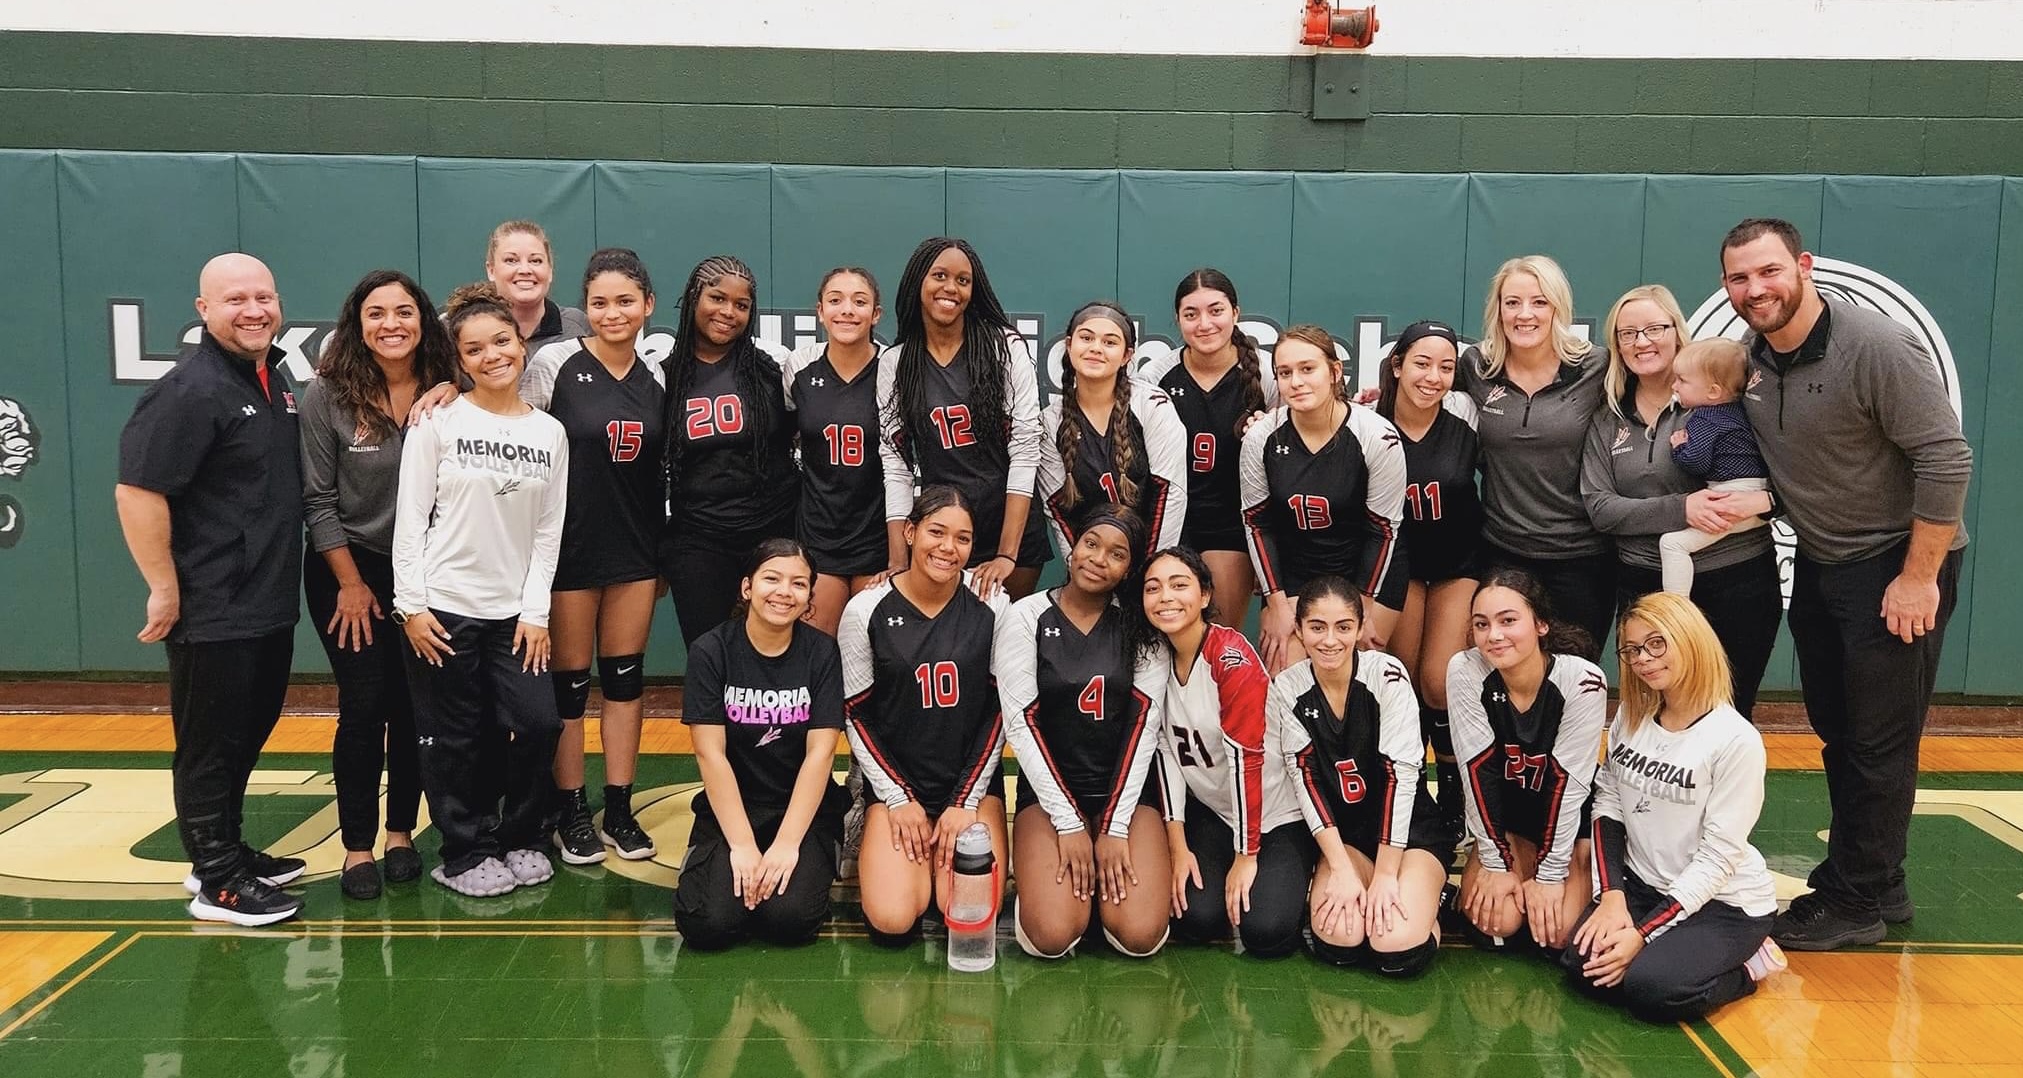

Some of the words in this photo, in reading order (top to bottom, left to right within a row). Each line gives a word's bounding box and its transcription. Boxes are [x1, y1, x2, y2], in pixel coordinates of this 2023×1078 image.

[686, 394, 744, 440] 20
[929, 404, 977, 450] 12
[606, 420, 644, 462] 15
[822, 424, 864, 467] 18
[1192, 432, 1216, 473] 9
[1099, 472, 1121, 505] 1
[1406, 481, 1442, 521] 11
[1287, 493, 1333, 531] 13
[724, 684, 812, 709] MEMORIA
[914, 660, 960, 709] 10
[1078, 674, 1105, 721] 4
[1171, 724, 1215, 768] 21
[1335, 758, 1367, 804] 6
[1504, 743, 1548, 793] 27
